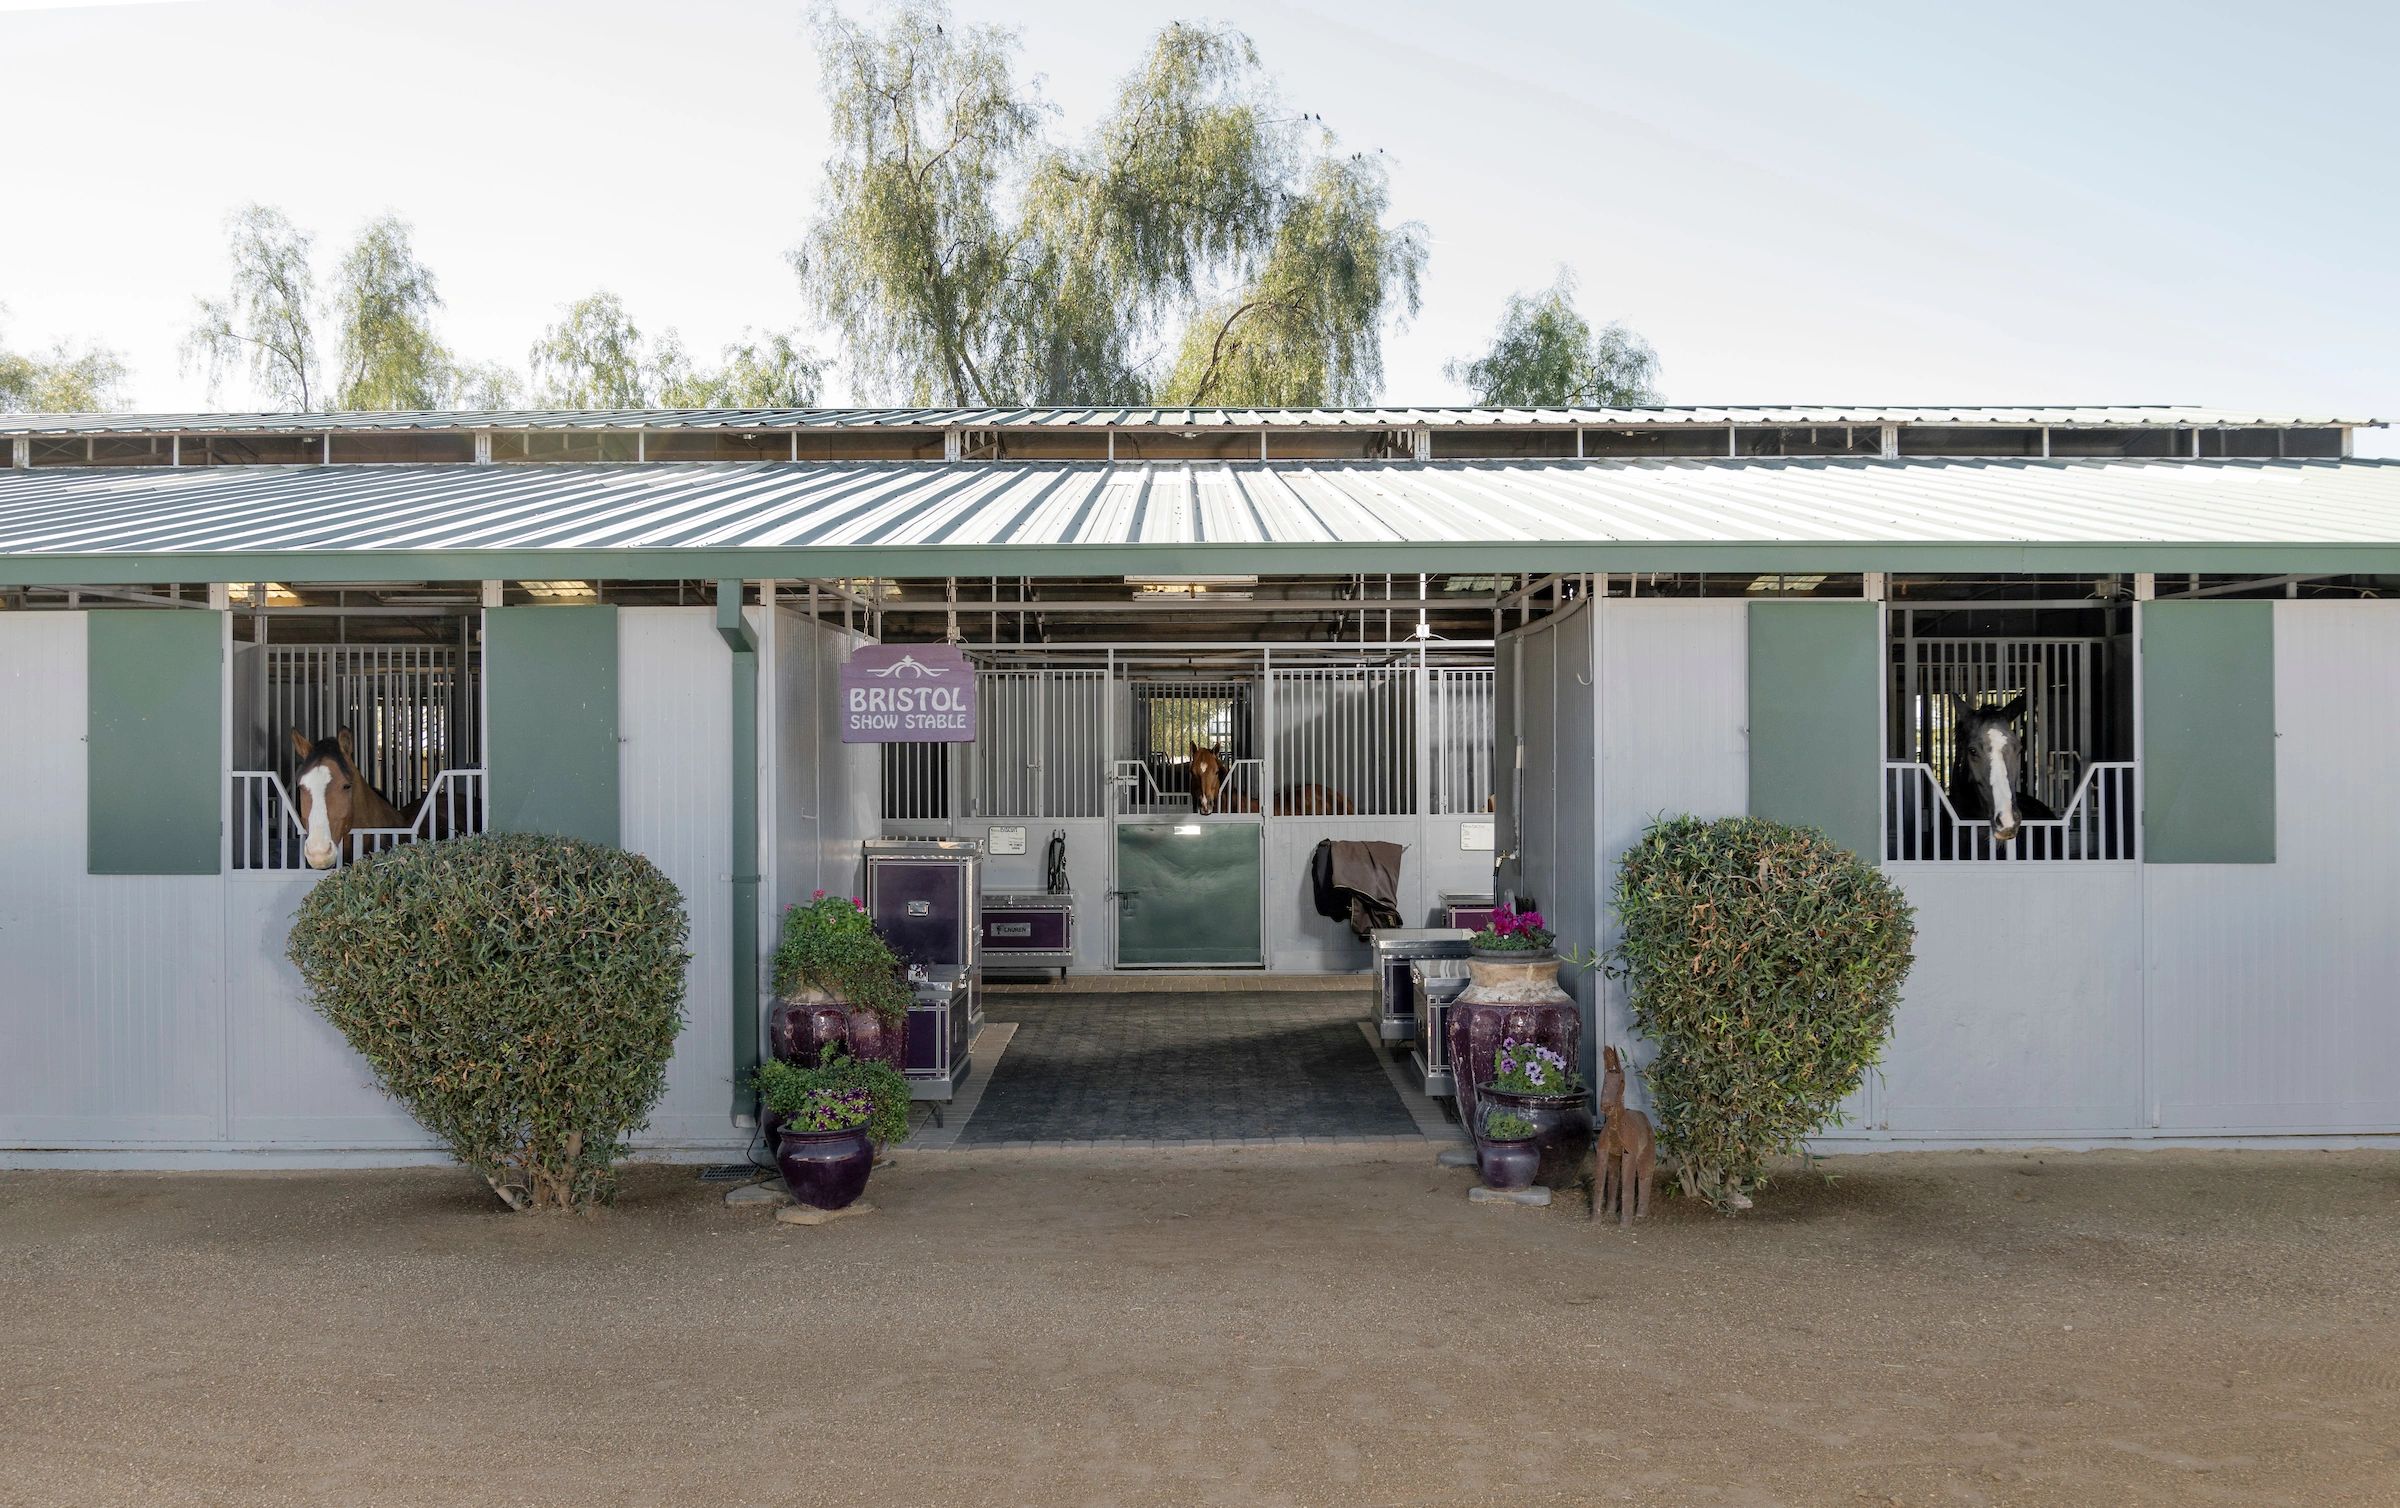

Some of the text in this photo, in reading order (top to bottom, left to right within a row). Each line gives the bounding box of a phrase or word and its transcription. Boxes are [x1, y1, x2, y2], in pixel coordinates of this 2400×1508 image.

[849, 687, 967, 712] BRISTOL
[850, 714, 967, 730] SHOW STABLE
